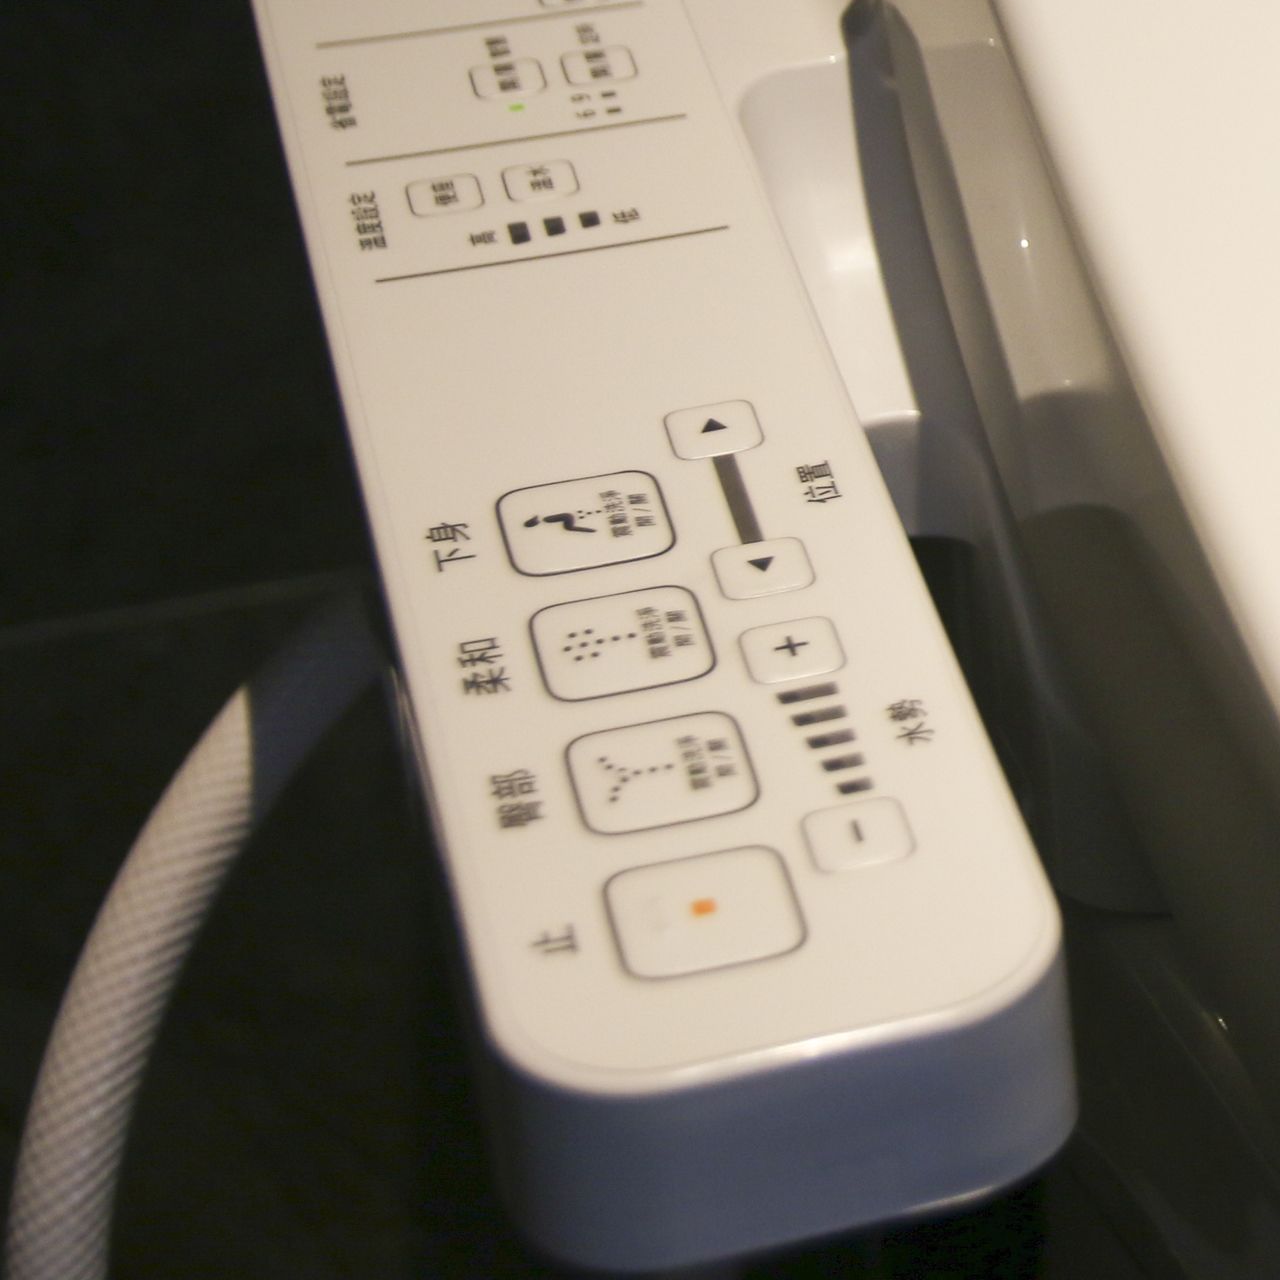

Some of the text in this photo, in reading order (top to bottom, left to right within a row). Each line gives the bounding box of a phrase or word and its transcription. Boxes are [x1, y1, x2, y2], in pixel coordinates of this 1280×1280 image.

[612, 206, 641, 224] 低
[795, 457, 843, 503] 位置
[426, 520, 478, 571] 下身
[458, 634, 514, 695] 柔和
[885, 697, 935, 745] 水勢
[491, 767, 547, 828] 臀部
[531, 921, 581, 955] 止
